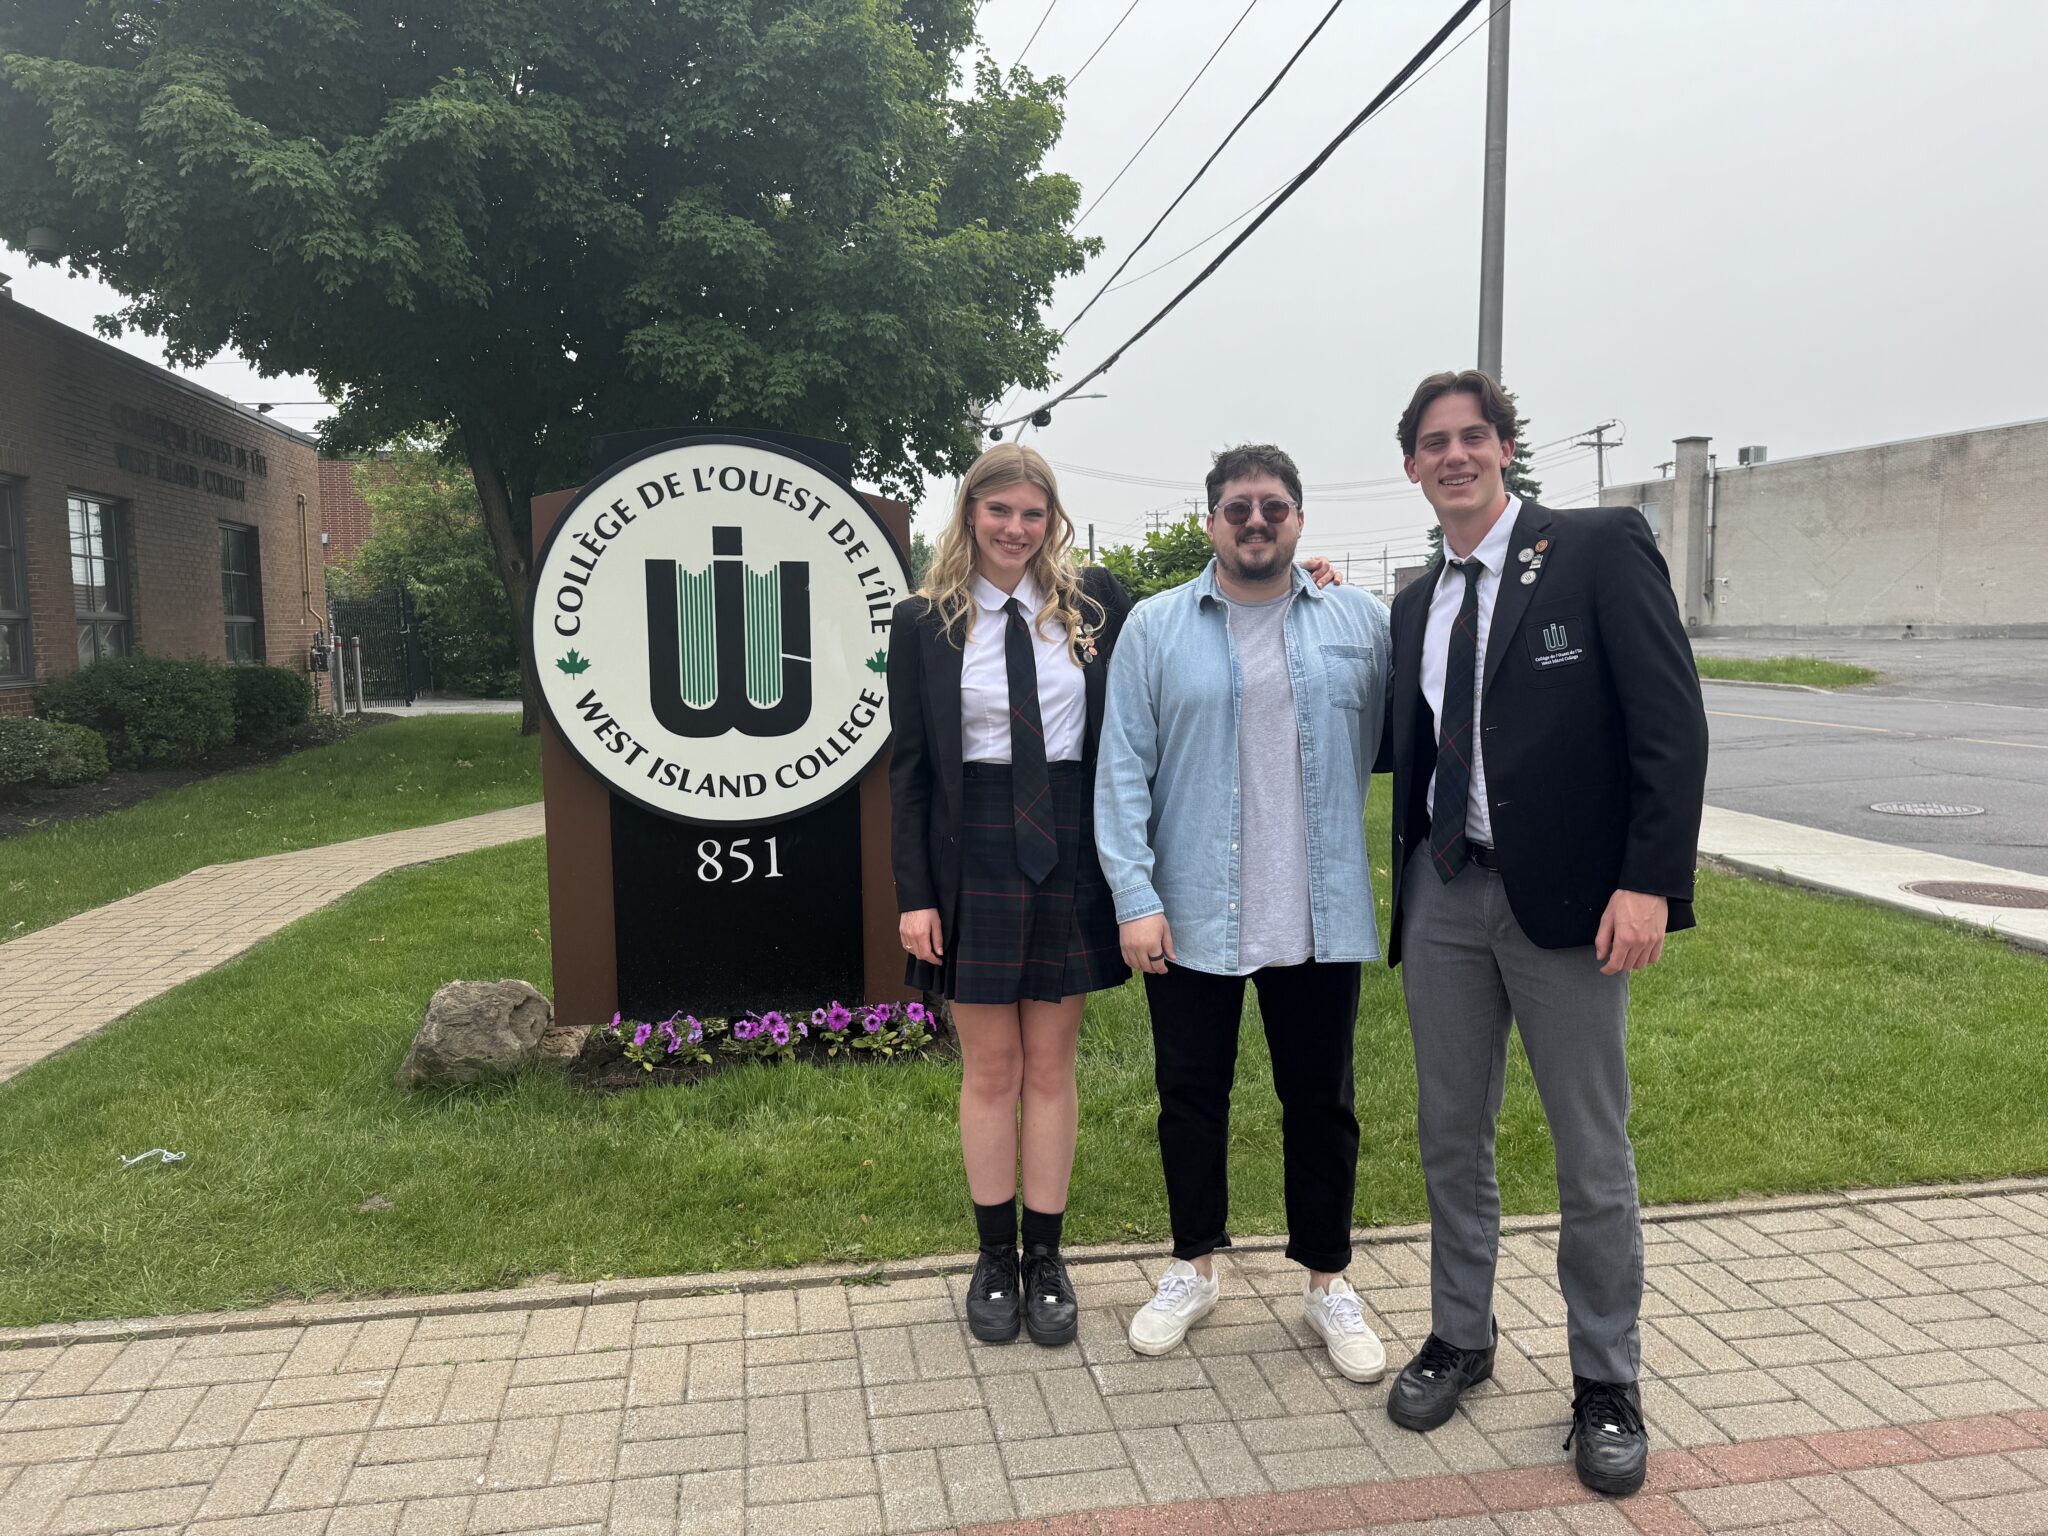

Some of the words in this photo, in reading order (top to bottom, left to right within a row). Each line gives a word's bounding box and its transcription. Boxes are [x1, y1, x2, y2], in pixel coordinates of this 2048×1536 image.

[554, 498, 637, 637] COLLÈGE
[637, 472, 685, 510] DE
[693, 466, 831, 522] L'OUEST
[827, 518, 870, 564] DE
[575, 688, 649, 766] WEST
[646, 756, 768, 798] ISLAND
[774, 687, 884, 789] COLLEGE
[697, 836, 784, 883] 851
